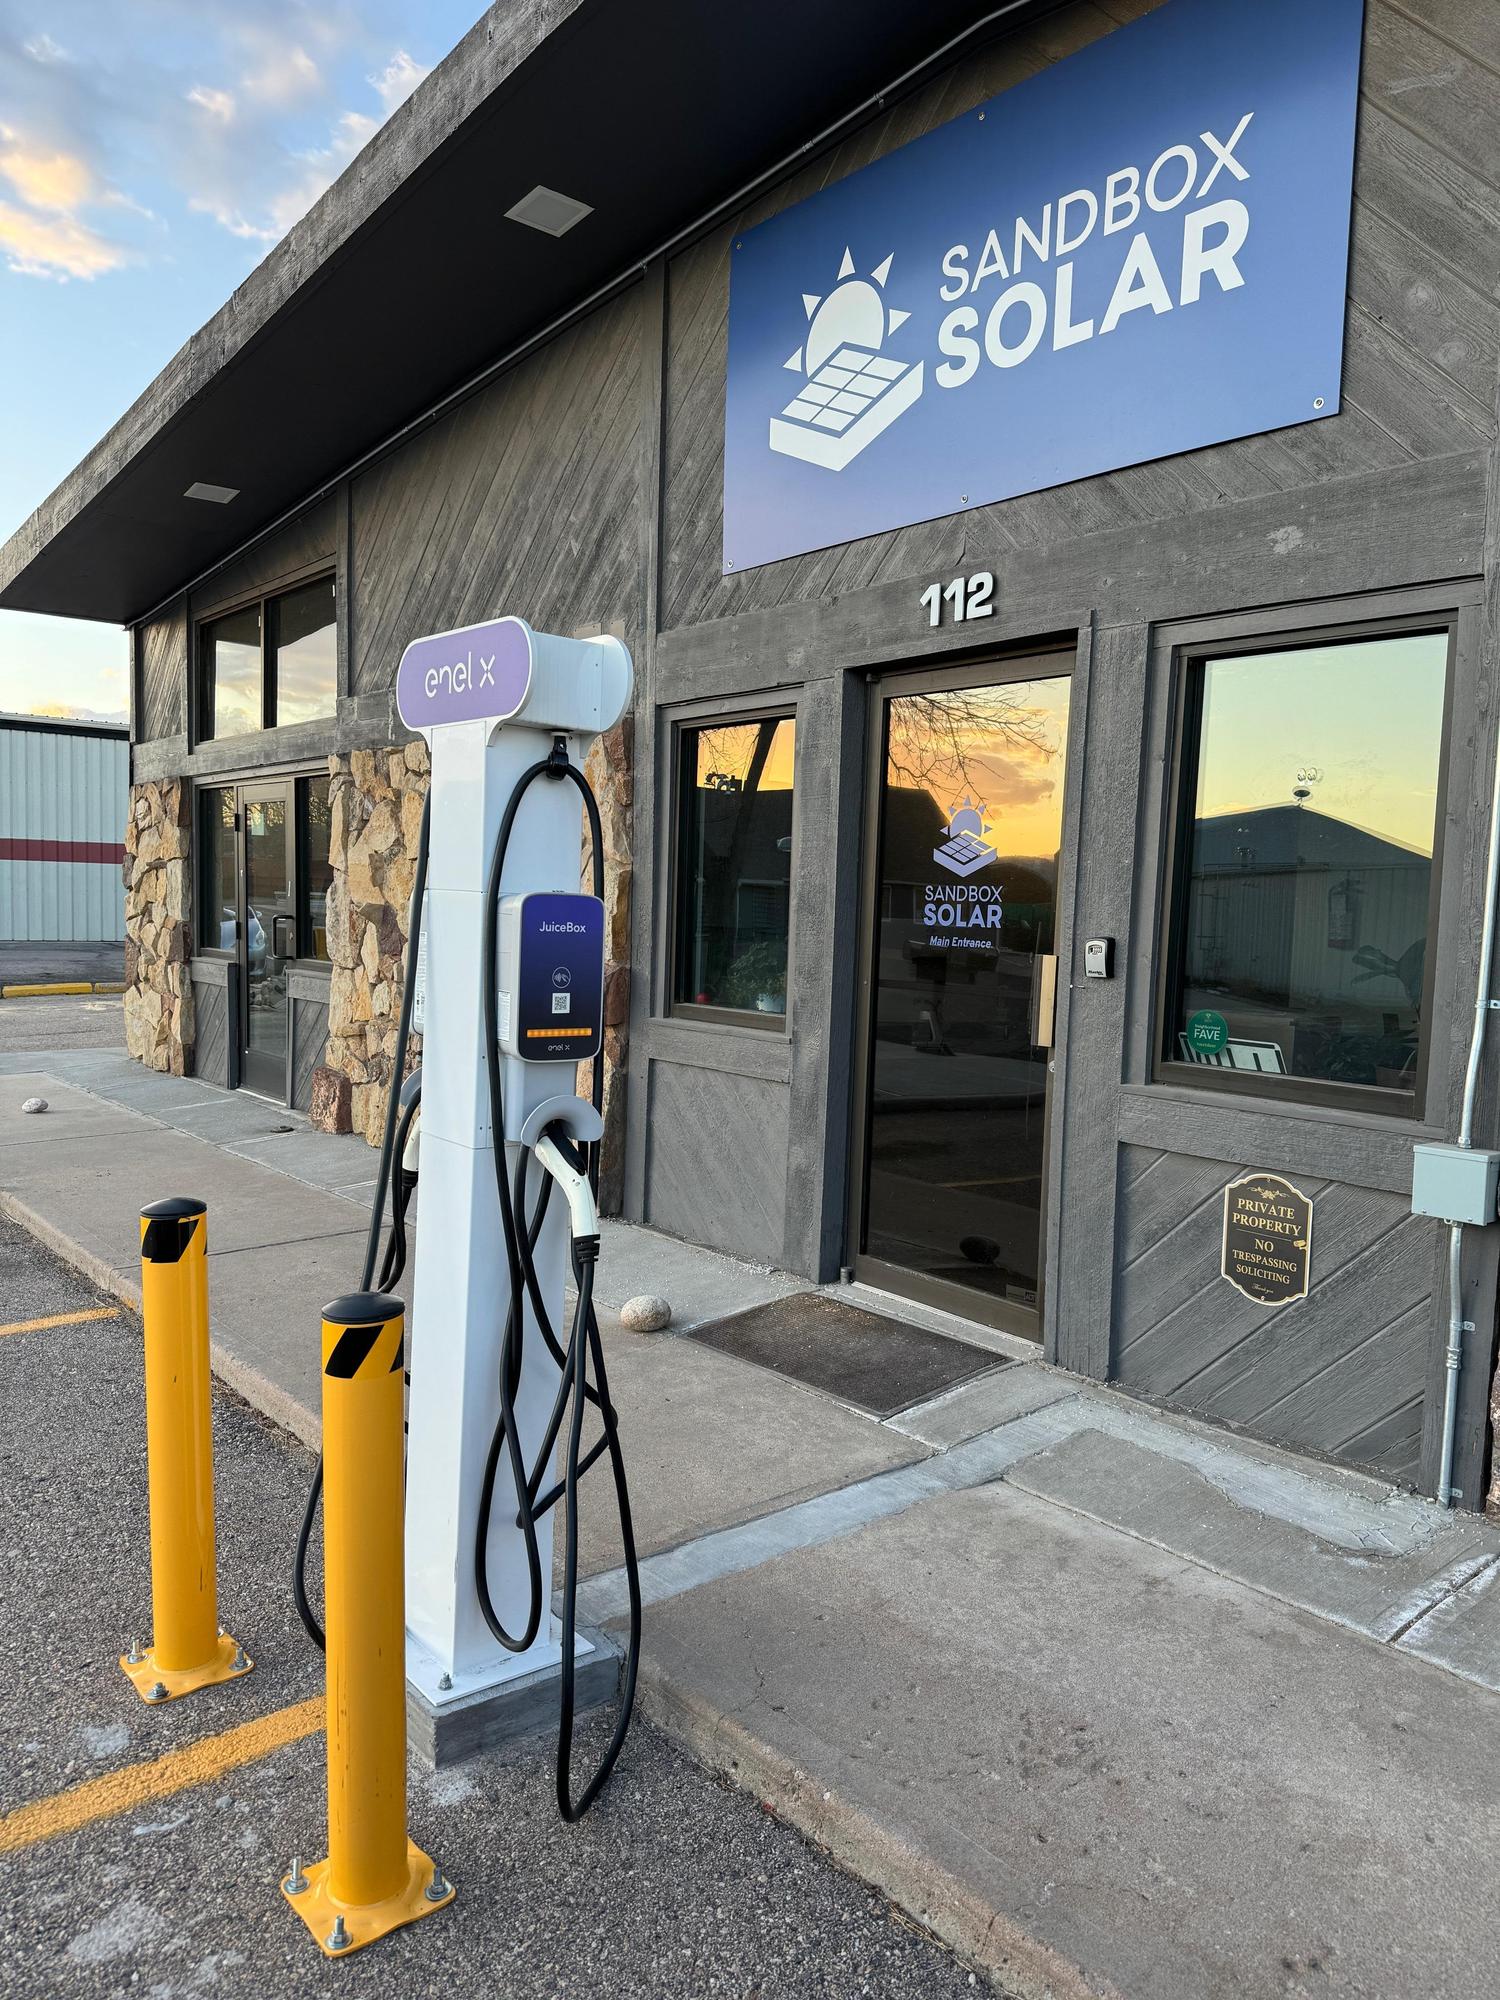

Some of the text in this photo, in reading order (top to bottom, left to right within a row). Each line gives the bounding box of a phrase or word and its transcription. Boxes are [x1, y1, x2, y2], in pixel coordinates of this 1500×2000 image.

[939, 112, 1254, 302] SANDBOX
[935, 199, 1250, 388] SOLAR
[920, 571, 994, 626] 112
[425, 651, 472, 698] enel
[924, 885, 1004, 902] SANDBOX
[539, 921, 587, 933] JuiceBox
[923, 903, 1003, 929] SOLAR
[929, 935, 950, 948] Main
[1194, 1029, 1220, 1040] FAVE
[1237, 1198, 1295, 1219] PRIVATE
[1232, 1212, 1302, 1237] PROPERTY
[1254, 1239, 1274, 1253] NO
[1232, 1249, 1297, 1272] TRESPASSING
[1236, 1264, 1290, 1285] SOLICITING
